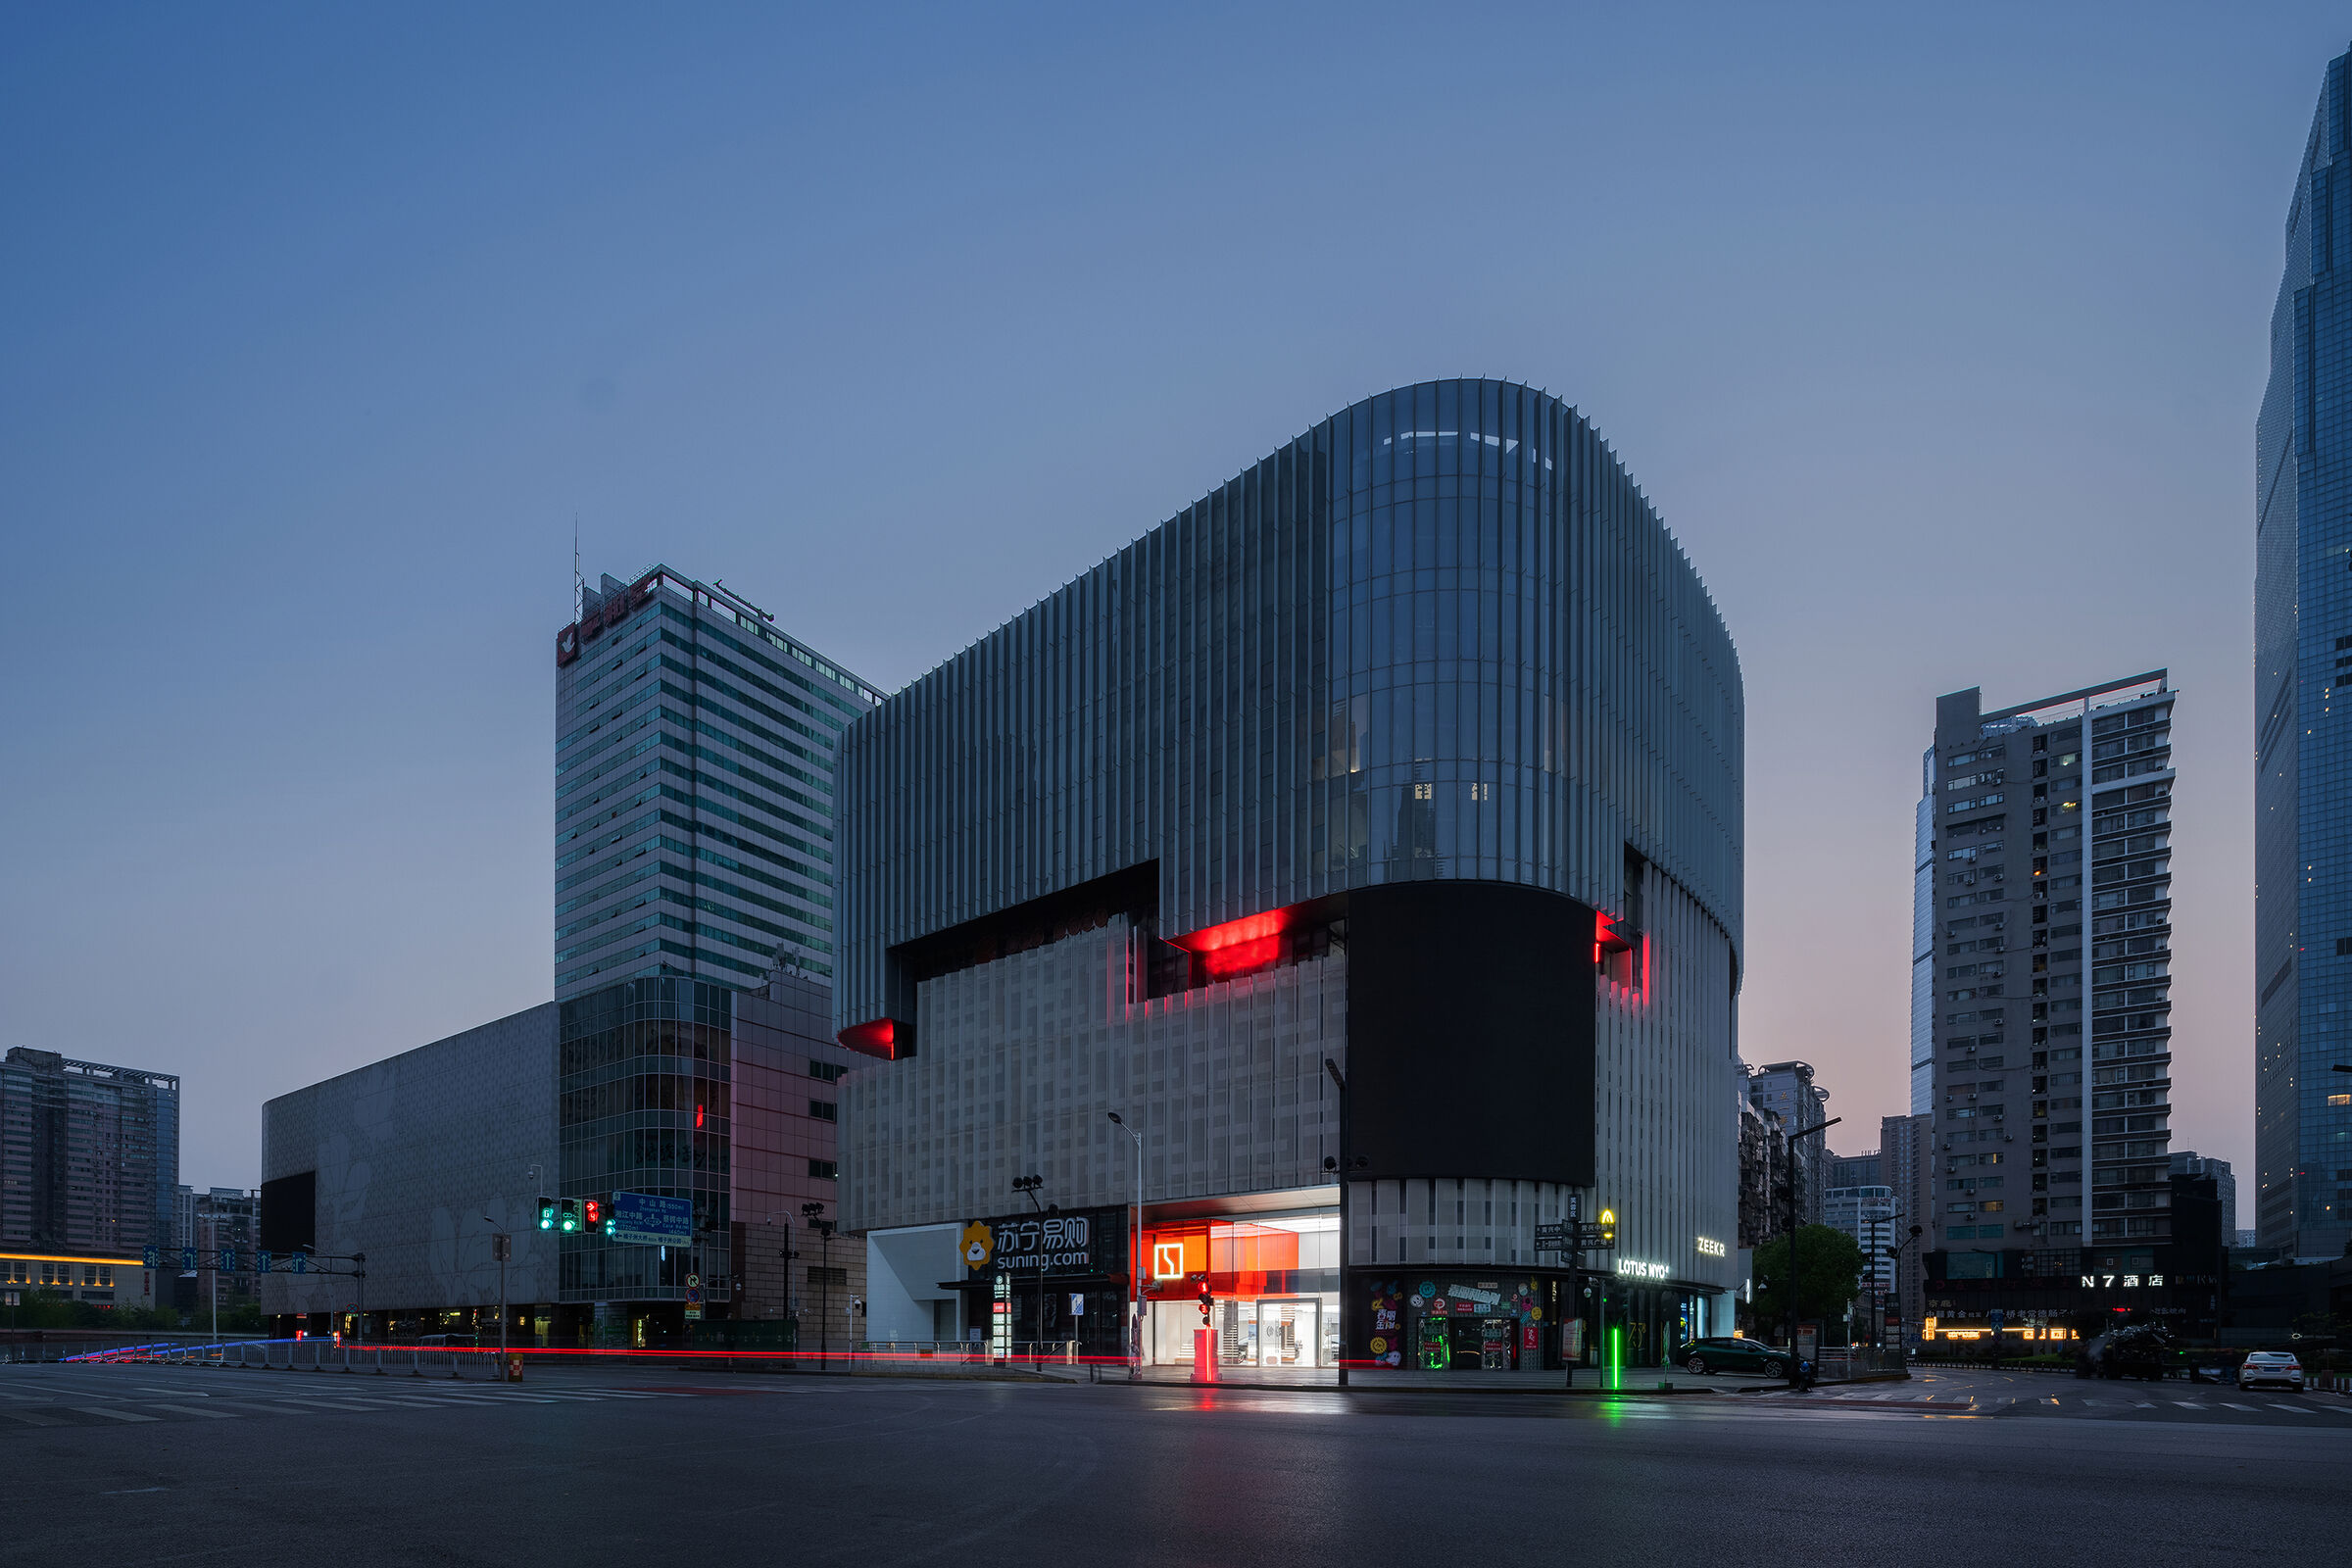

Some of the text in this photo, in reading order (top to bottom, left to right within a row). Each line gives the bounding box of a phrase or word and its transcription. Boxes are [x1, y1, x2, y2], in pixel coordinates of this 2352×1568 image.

[997, 1216, 1090, 1253] 苏宁易购
[1697, 1237, 1725, 1257] ZEEKR
[997, 1251, 1089, 1272] suning.com
[1618, 1258, 1647, 1277] LOTUS
